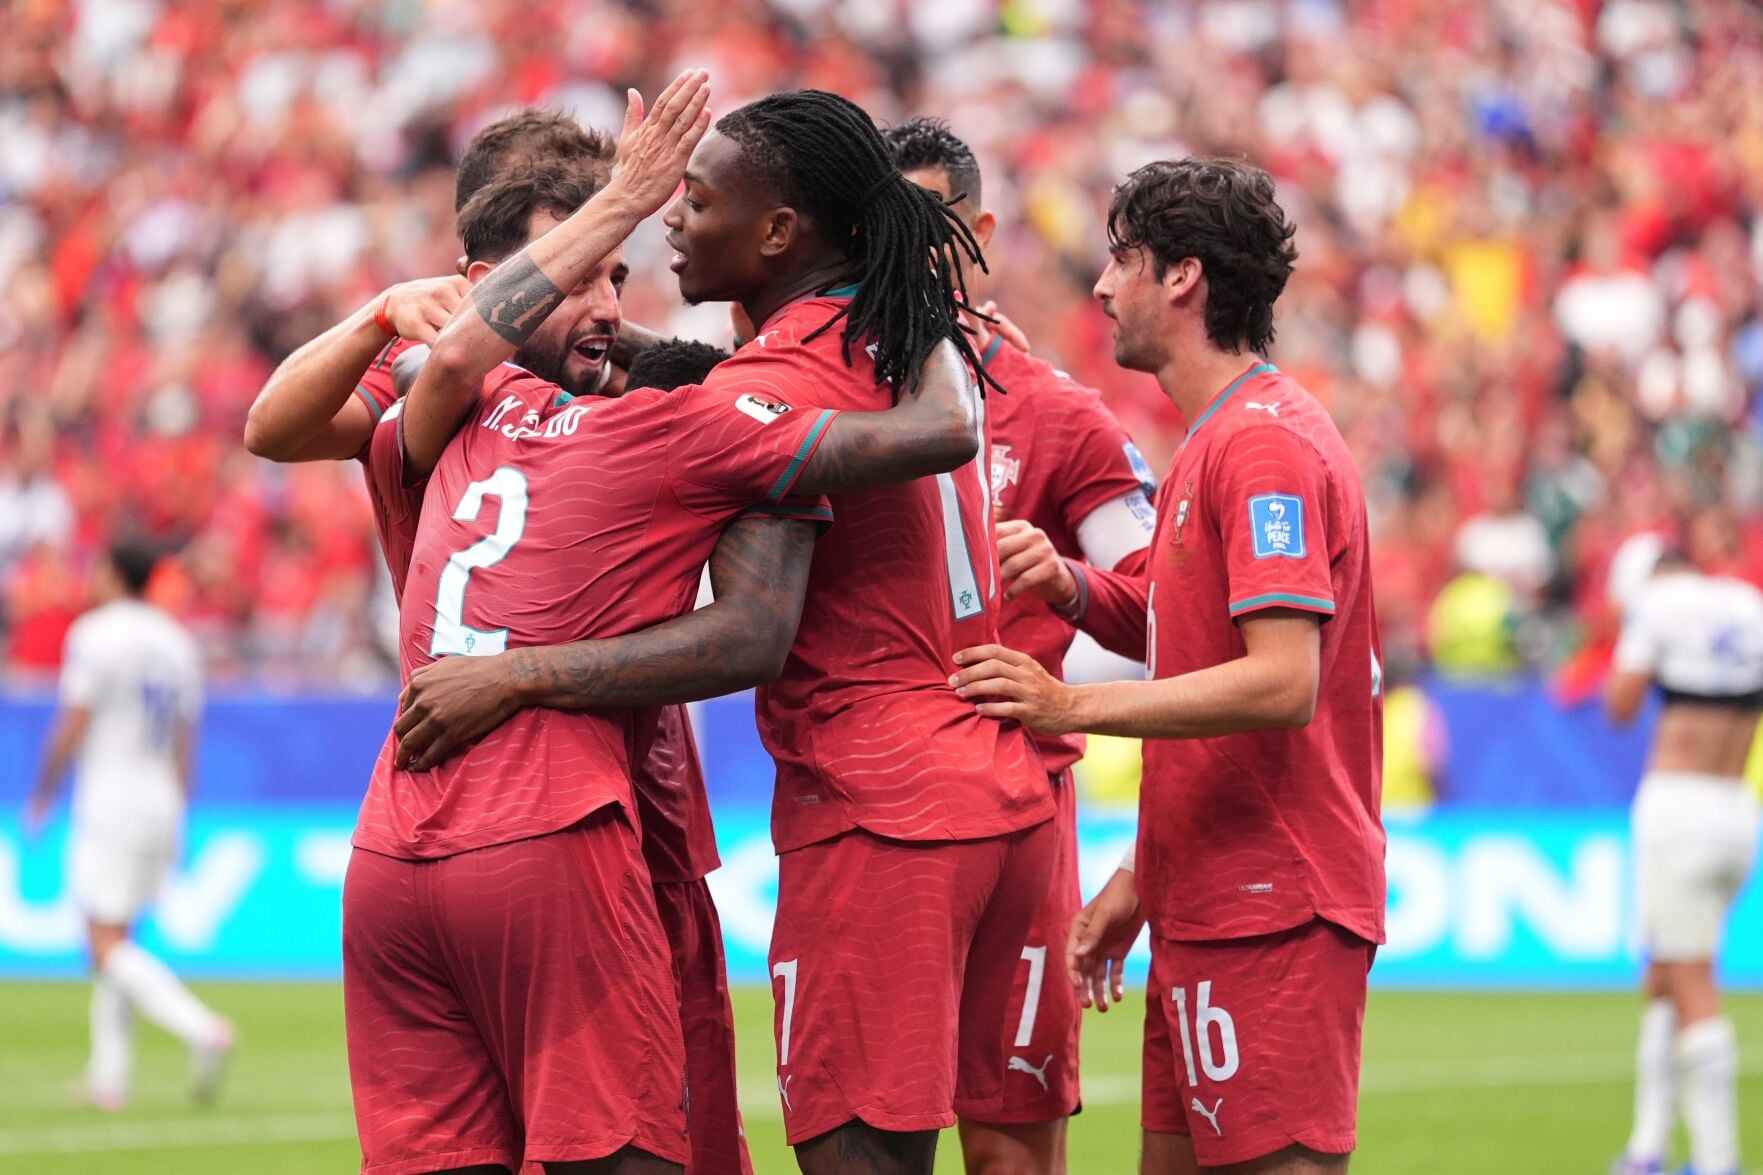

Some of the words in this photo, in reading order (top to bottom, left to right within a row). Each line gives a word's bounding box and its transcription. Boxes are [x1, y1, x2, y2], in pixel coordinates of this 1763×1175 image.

[429, 465, 529, 658] 2
[1267, 530, 1291, 545] PEACE
[1171, 979, 1240, 1087] 16
